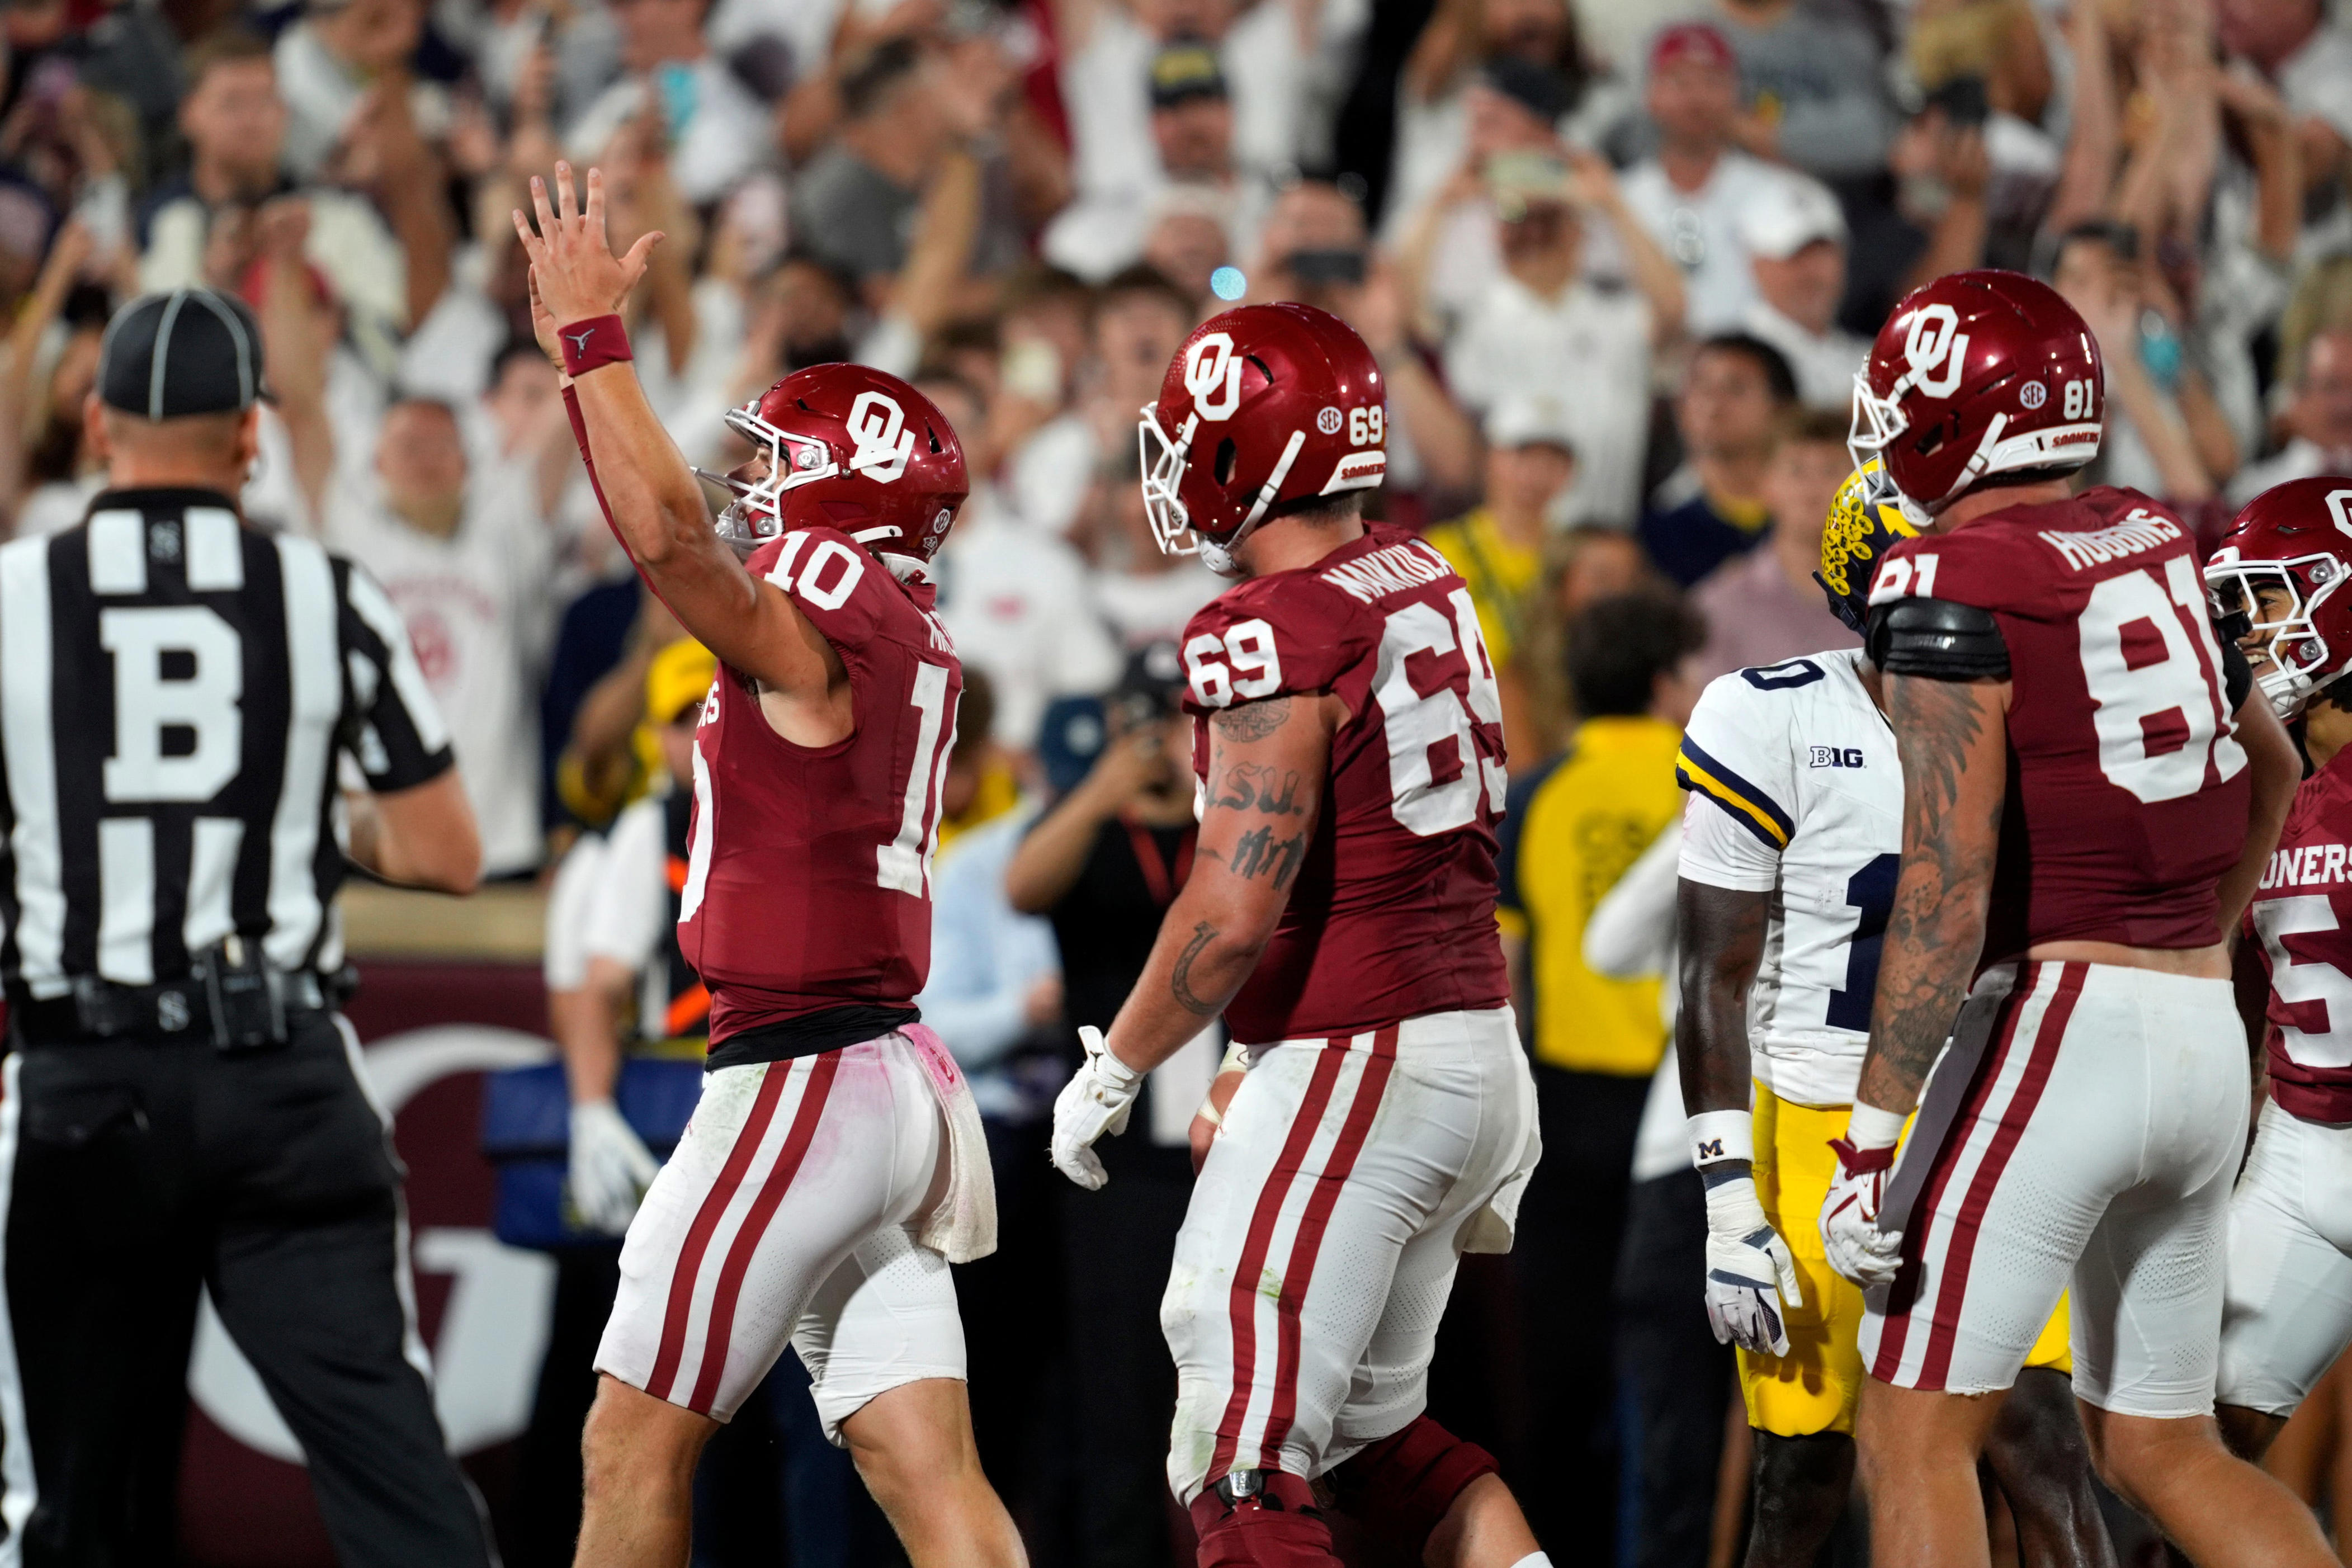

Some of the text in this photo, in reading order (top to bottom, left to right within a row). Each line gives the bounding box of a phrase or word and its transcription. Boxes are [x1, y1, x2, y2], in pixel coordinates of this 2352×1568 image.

[1184, 332, 1243, 421] OU
[1905, 304, 1970, 399] OU
[1320, 409, 1339, 431] SEC
[1349, 405, 1383, 446] 69
[2023, 384, 2043, 405] SEC
[2063, 379, 2093, 420] 81
[846, 391, 915, 484] OU
[2052, 432, 2099, 447] SOONERS
[764, 531, 865, 611] 10
[2038, 508, 2182, 572] HUGGINS
[1184, 618, 1282, 708] 69
[2078, 554, 2248, 804] 81
[99, 604, 244, 804] B
[2252, 895, 2352, 1068] 5
[1698, 1139, 1724, 1160] M
